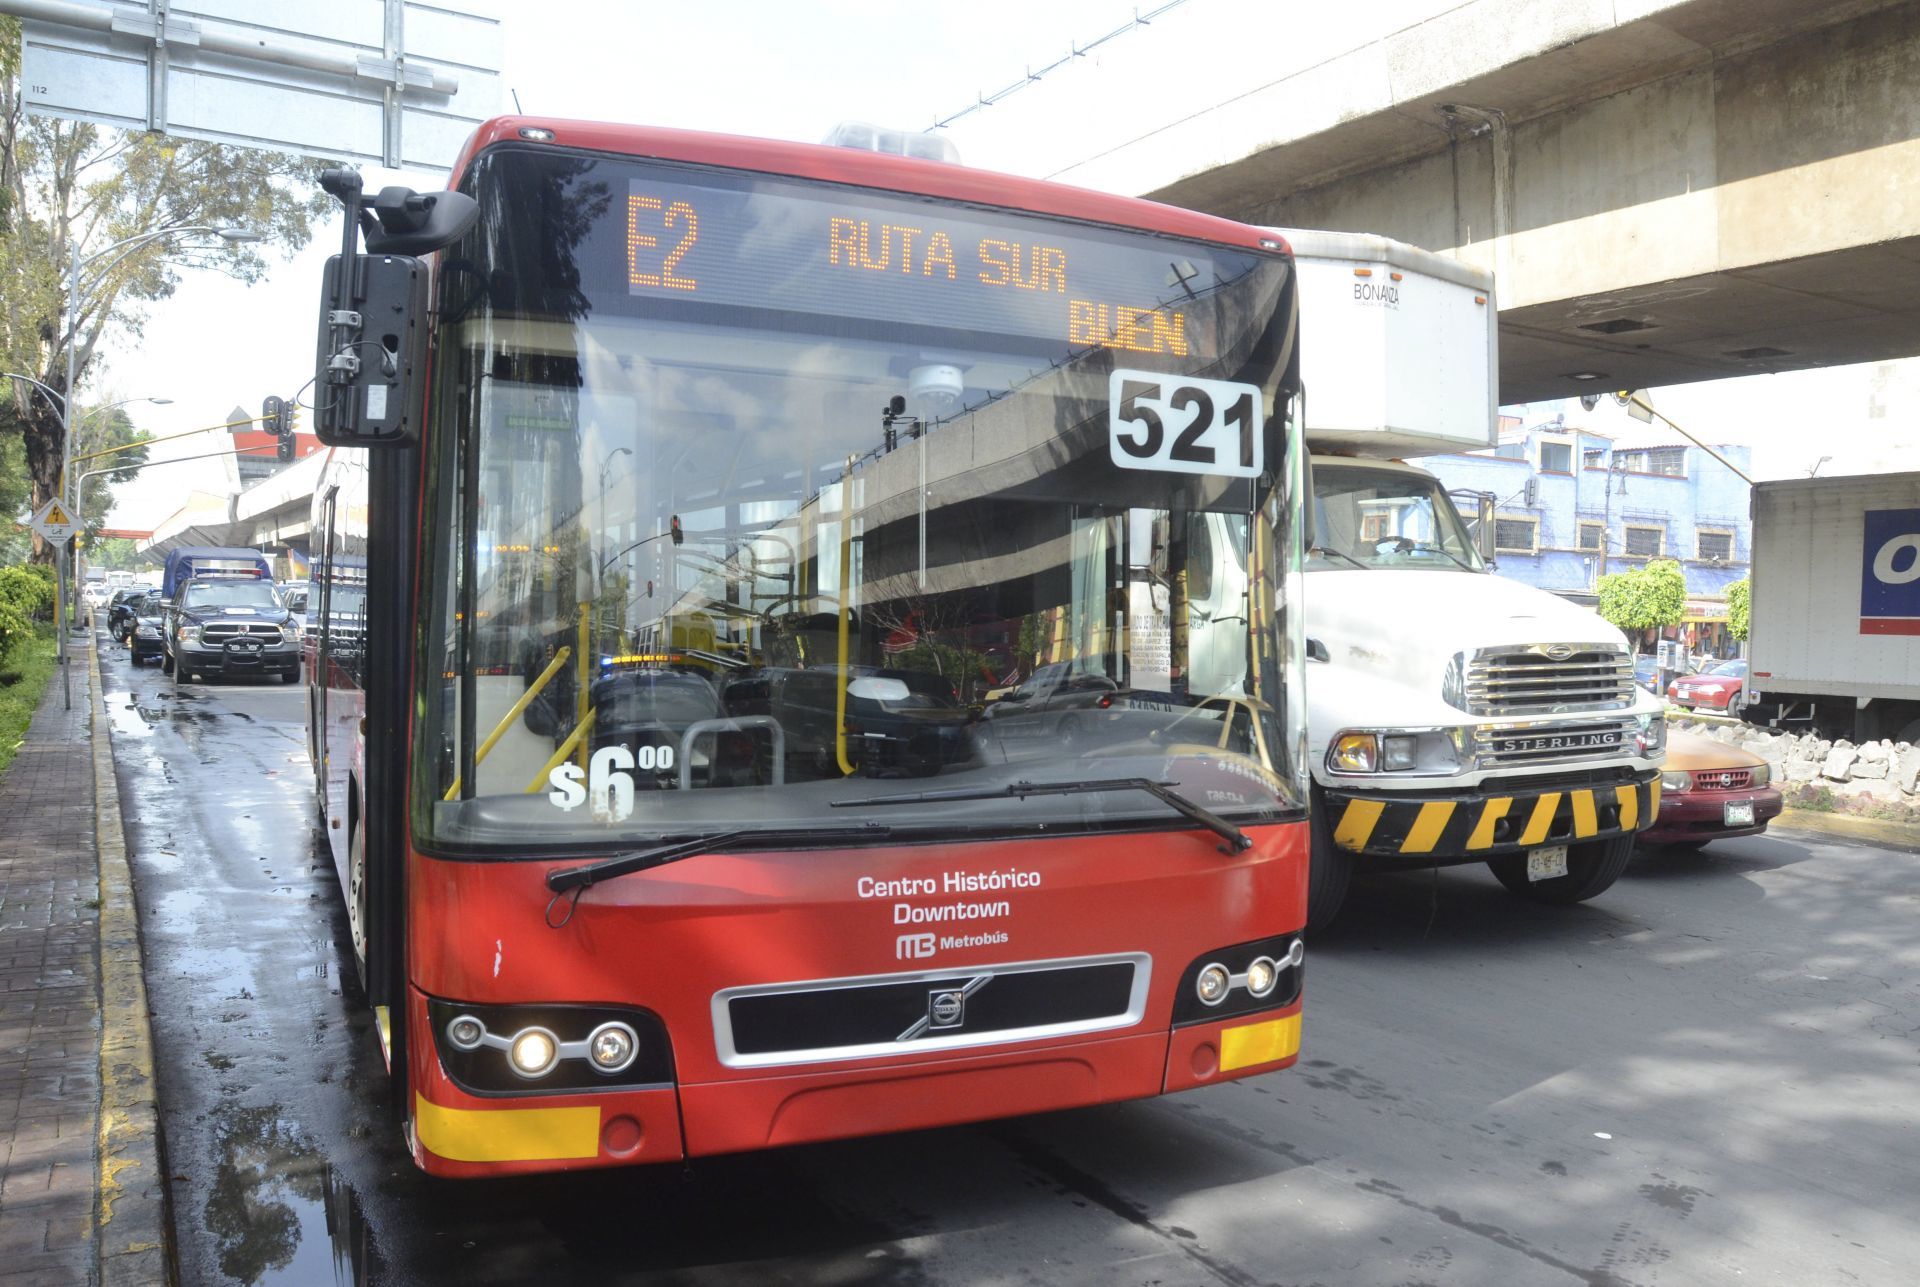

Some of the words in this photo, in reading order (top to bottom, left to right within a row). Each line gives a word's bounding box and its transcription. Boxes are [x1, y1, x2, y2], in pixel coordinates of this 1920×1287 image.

[32, 85, 48, 95] 112
[627, 195, 697, 290] E2
[830, 217, 956, 279] RUTA
[978, 239, 1065, 293] SUR
[1354, 283, 1400, 305] BONANZA
[1069, 300, 1188, 357] BUEN
[1116, 379, 1254, 468] 521
[1503, 733, 1615, 751] STERLING
[857, 876, 936, 898] Centro
[943, 867, 1041, 893] Histórico
[893, 901, 1010, 924] Downtown
[940, 930, 1009, 950] Metrobús
